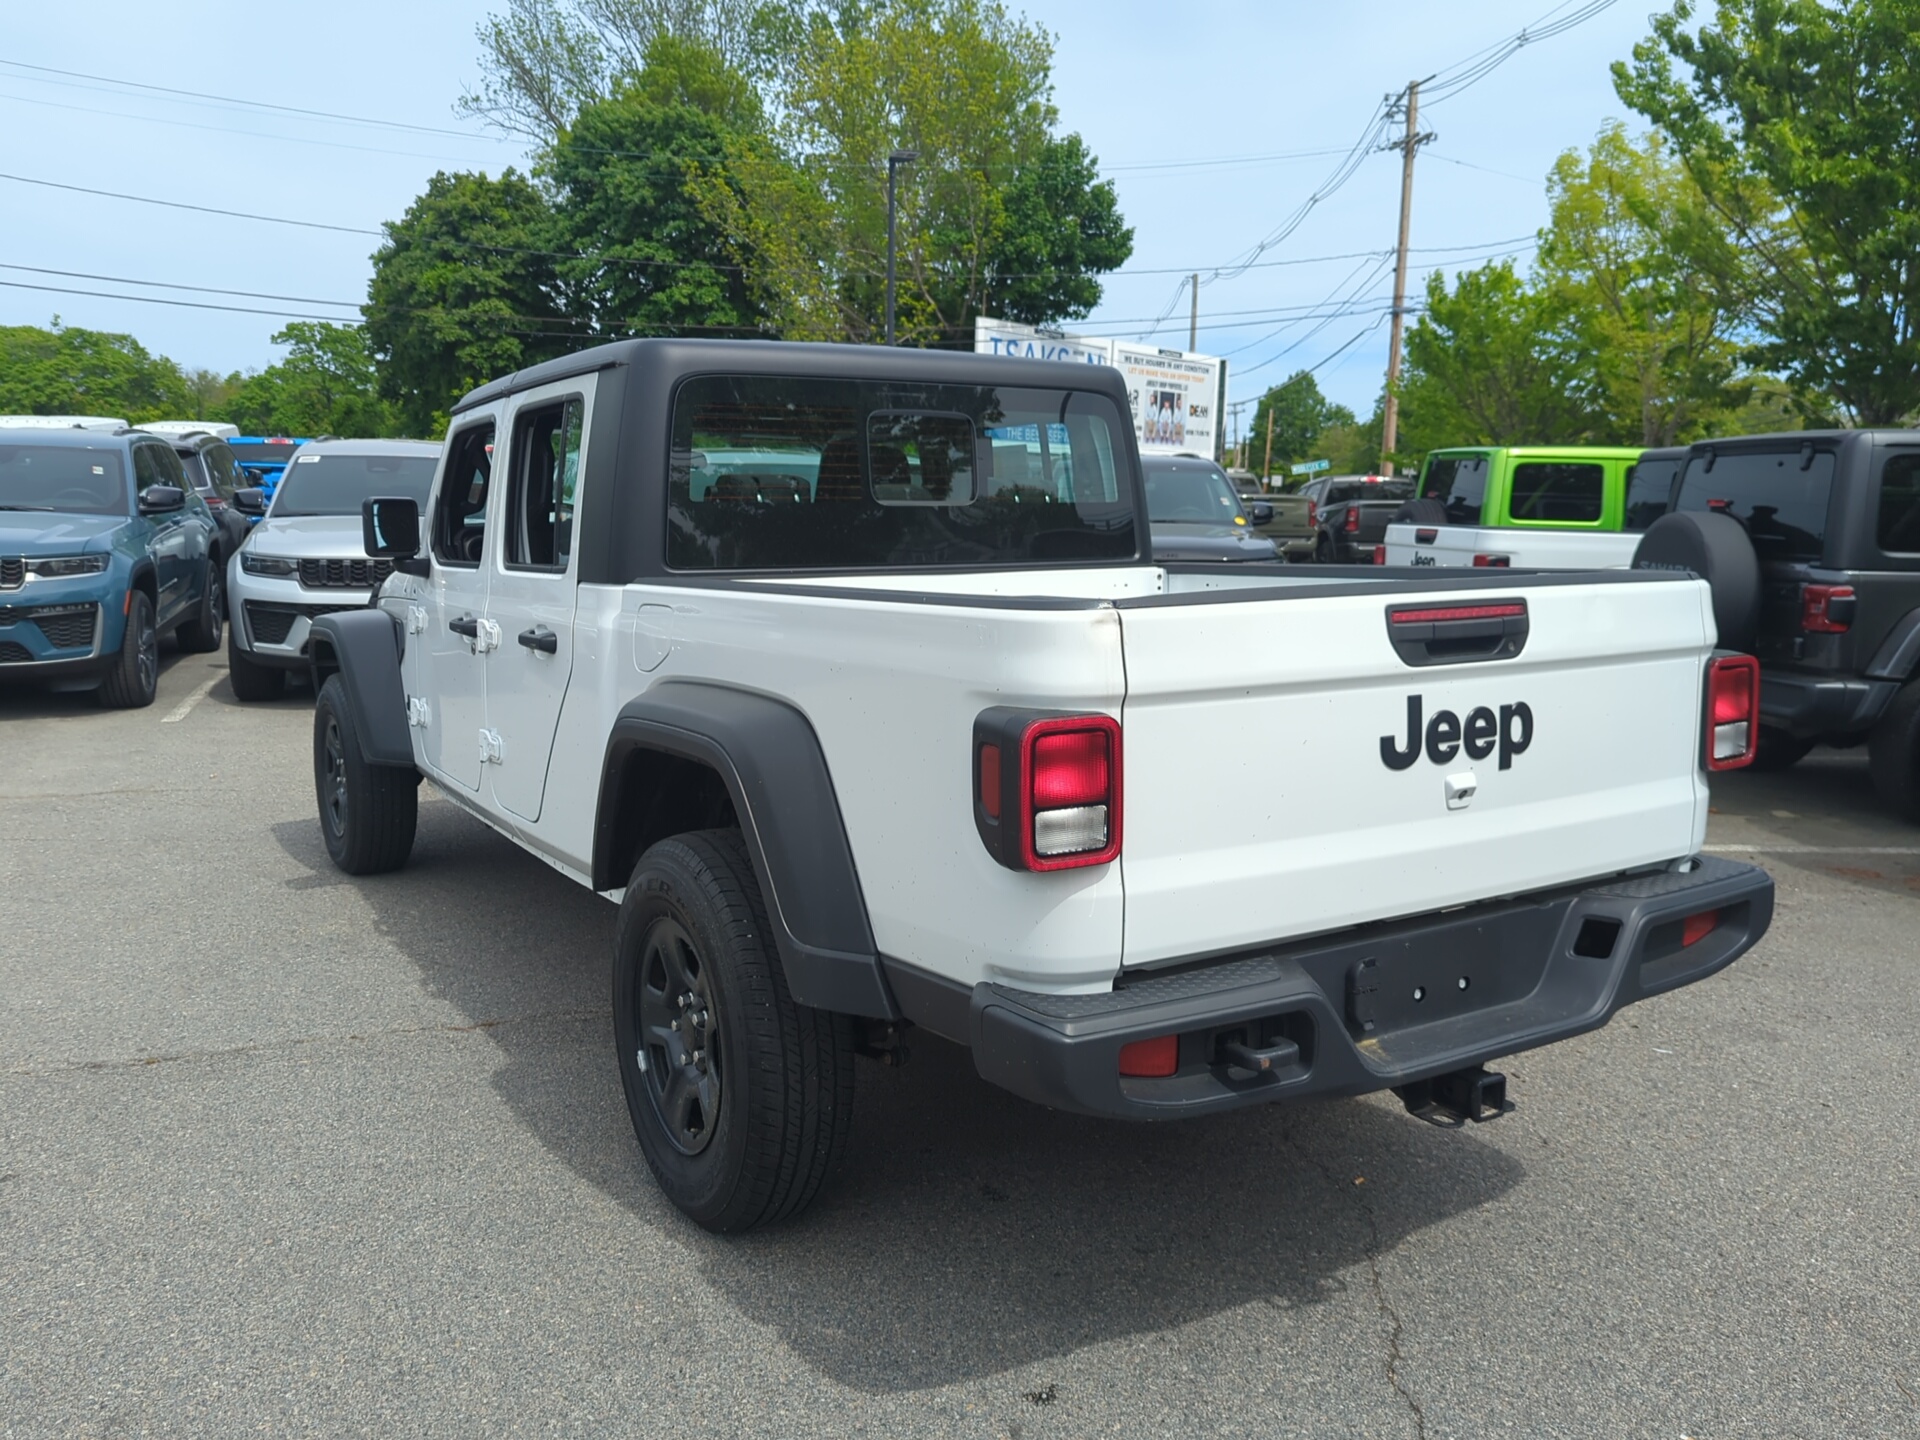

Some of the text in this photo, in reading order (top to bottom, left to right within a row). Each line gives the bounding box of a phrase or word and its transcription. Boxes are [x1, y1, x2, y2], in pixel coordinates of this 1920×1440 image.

[1184, 364, 1209, 374] CONDITION
[1007, 427, 1023, 440] THE
[1380, 694, 1534, 771] Jeep
